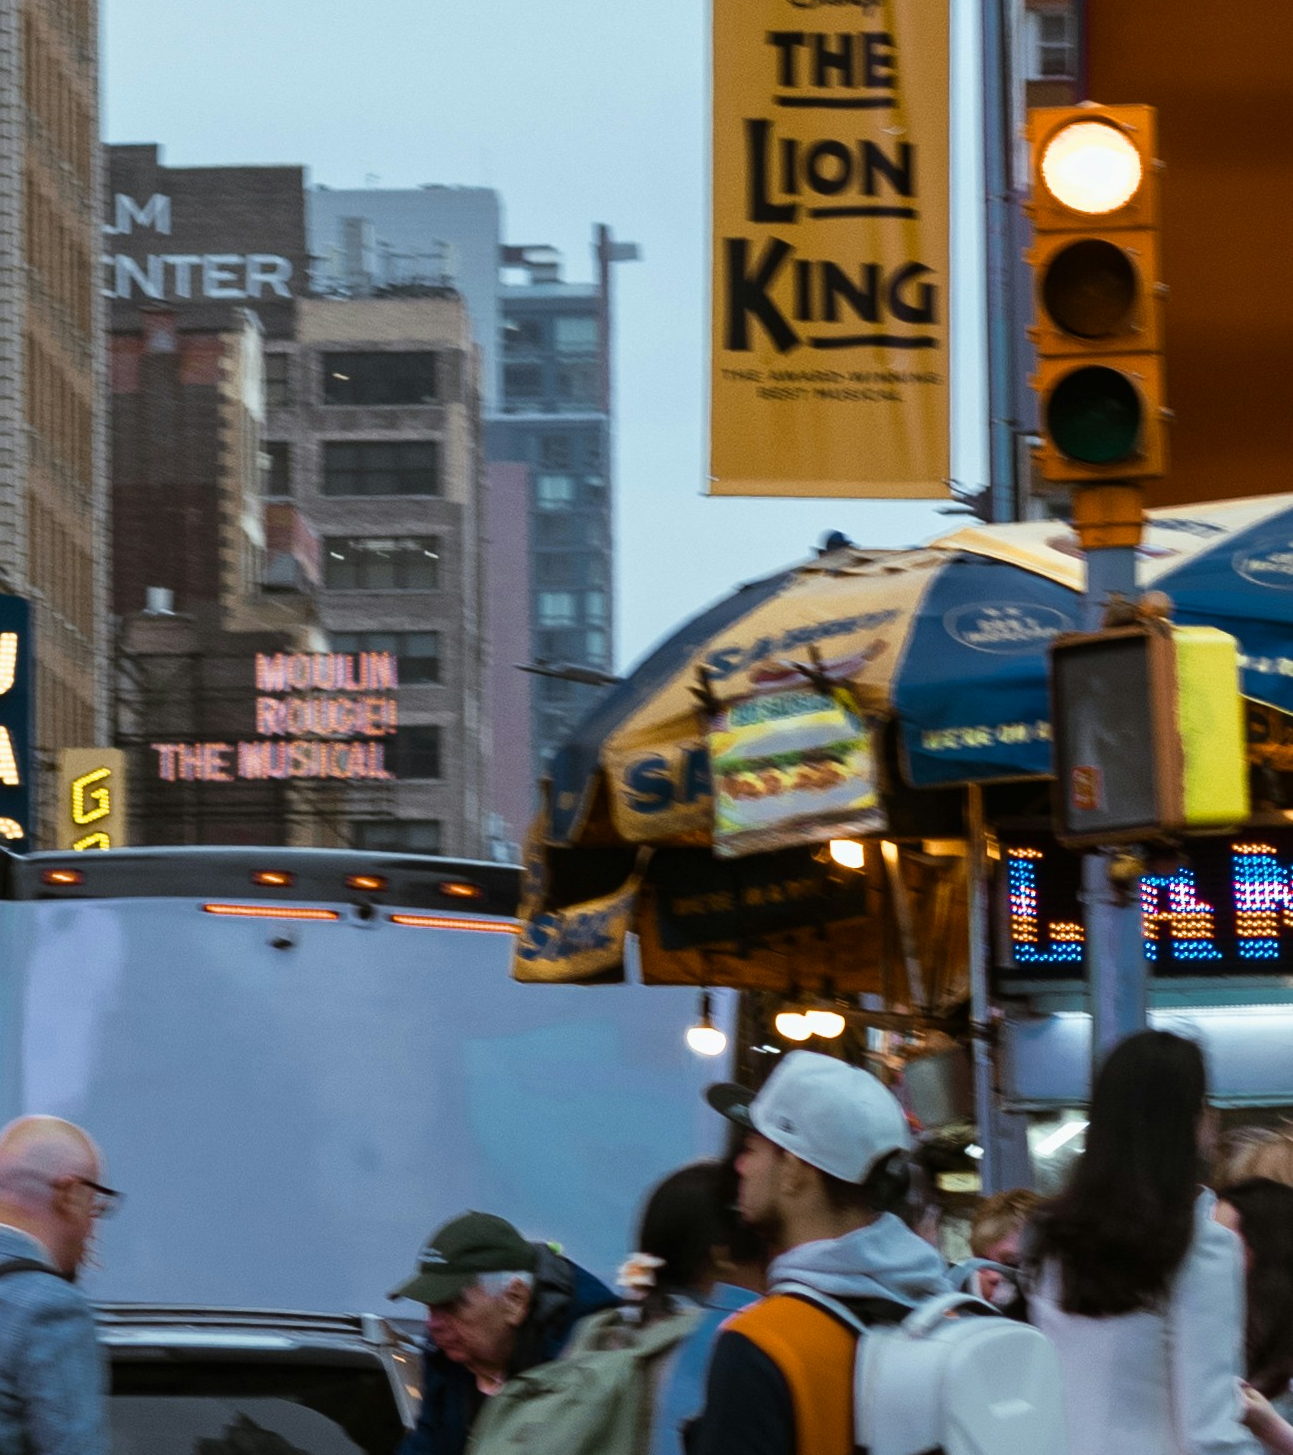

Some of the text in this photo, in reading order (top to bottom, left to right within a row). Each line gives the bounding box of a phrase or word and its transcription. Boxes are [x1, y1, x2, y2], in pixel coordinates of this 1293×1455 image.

[765, 30, 899, 90] THE
[255, 651, 399, 692] MOULIN
[150, 741, 398, 782] THE MUSICAL
